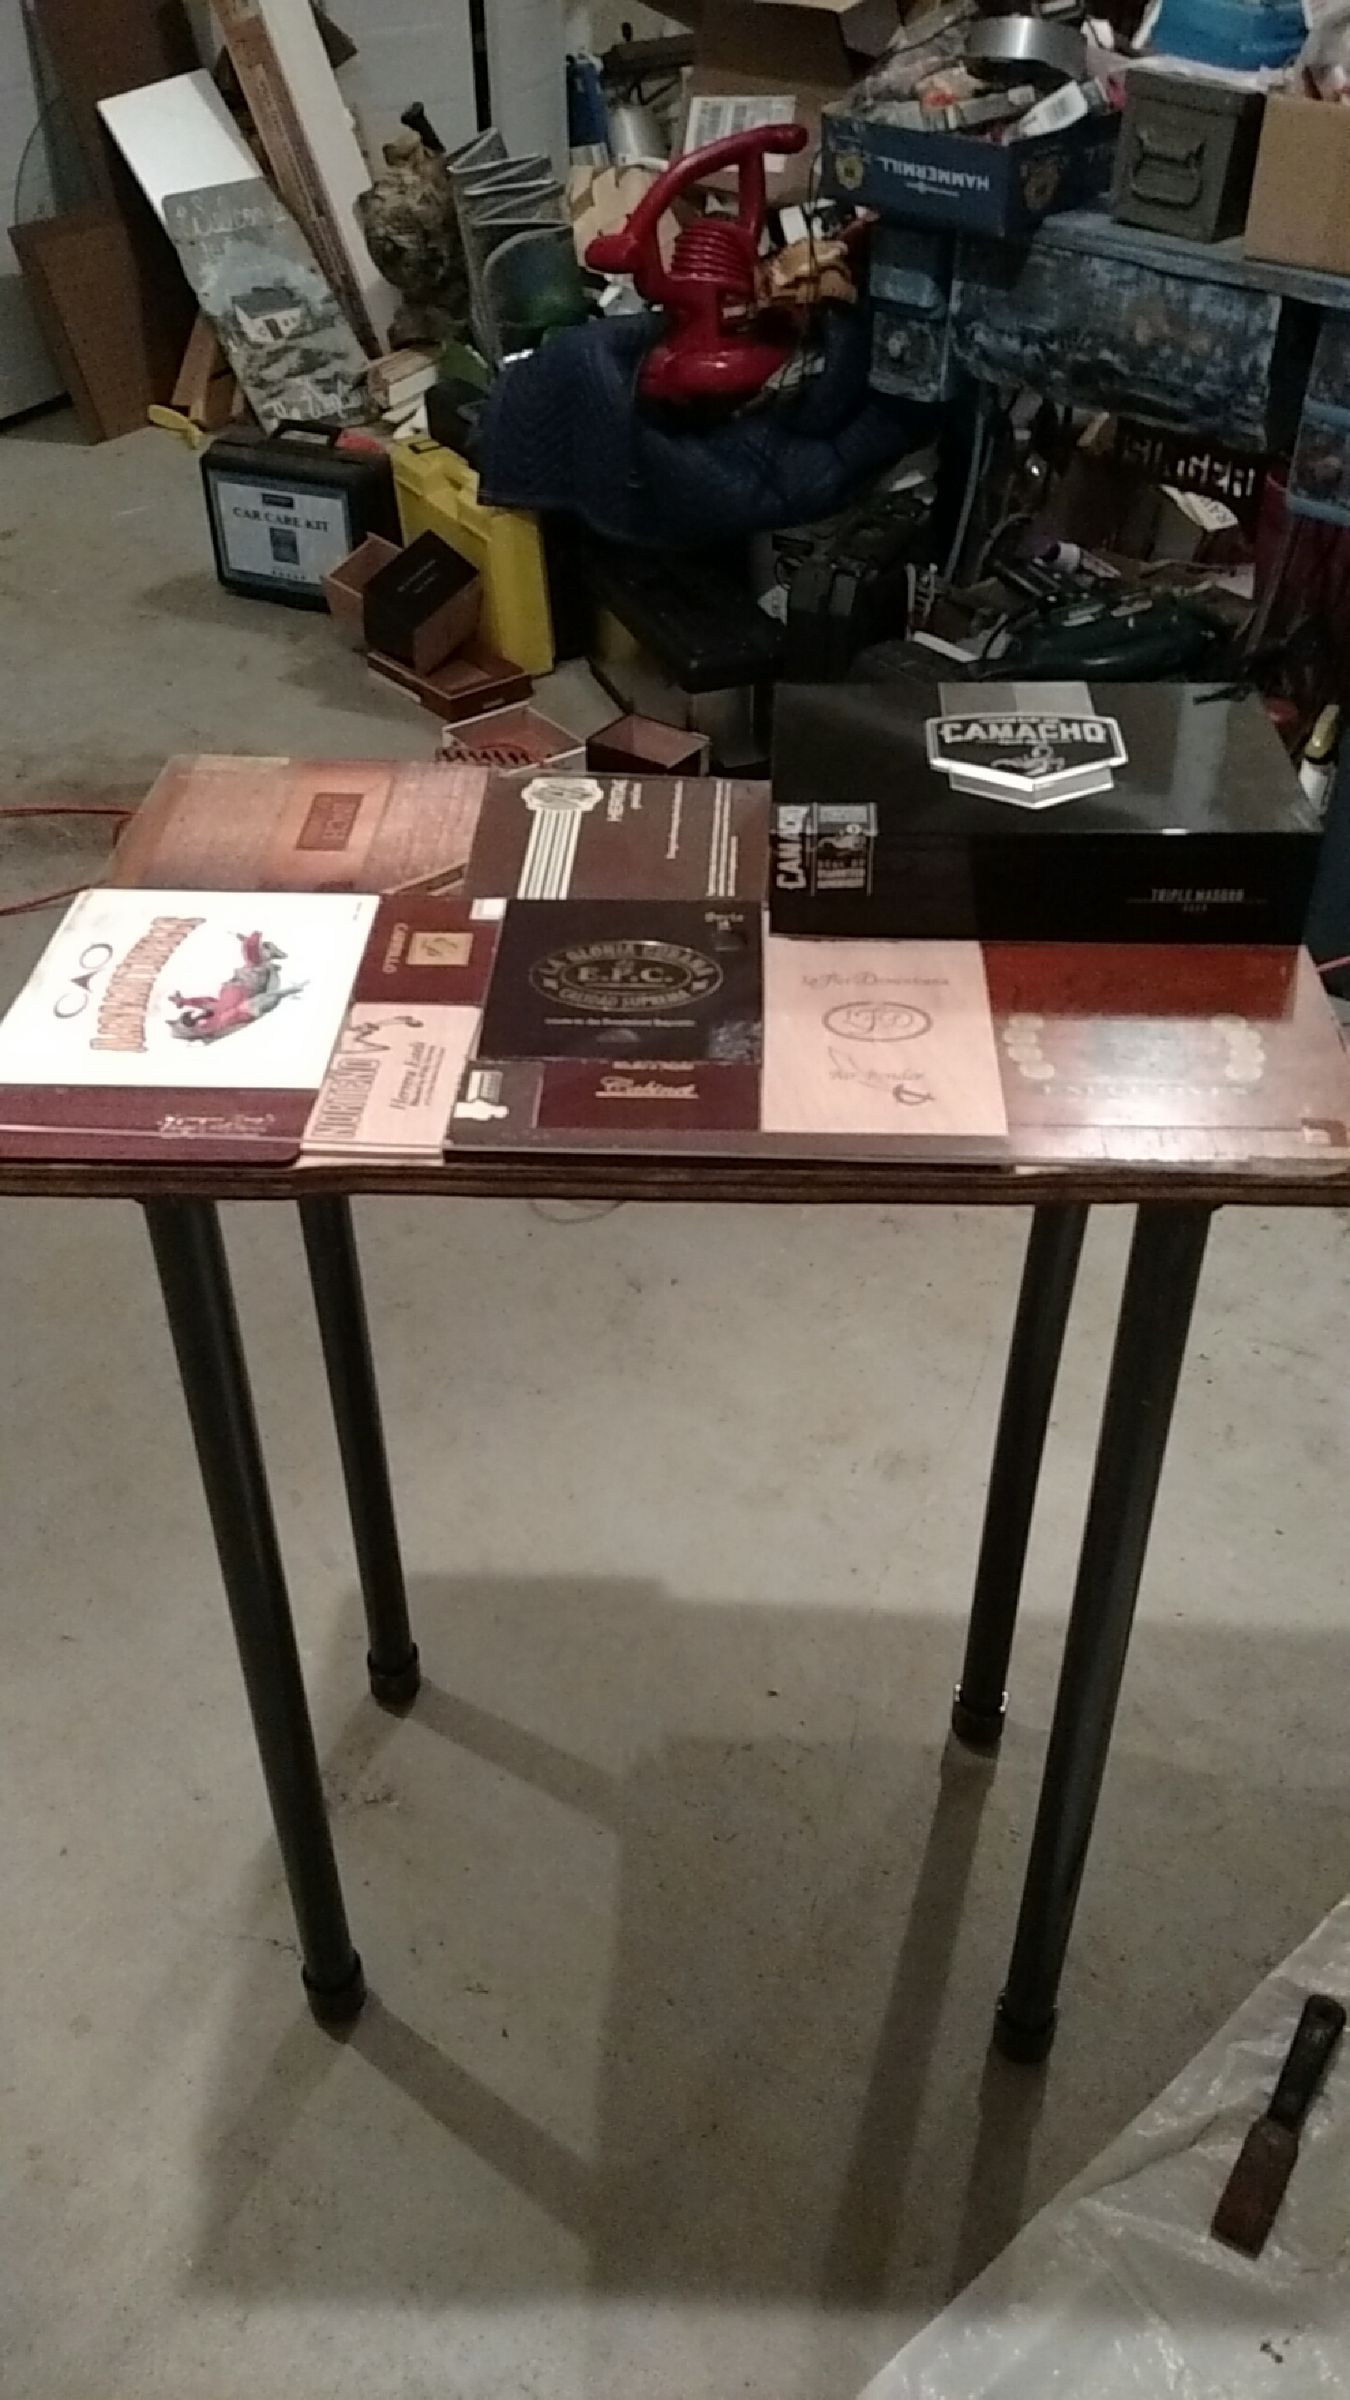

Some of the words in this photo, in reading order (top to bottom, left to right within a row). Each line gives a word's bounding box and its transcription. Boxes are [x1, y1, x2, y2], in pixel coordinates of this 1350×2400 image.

[877, 156, 989, 191] HAMMERMILL
[232, 506, 262, 521] CAR
[264, 511, 302, 528] CARE
[305, 519, 329, 533] KIT
[939, 722, 1106, 744] CAMACHO
[53, 944, 113, 1019] CAO
